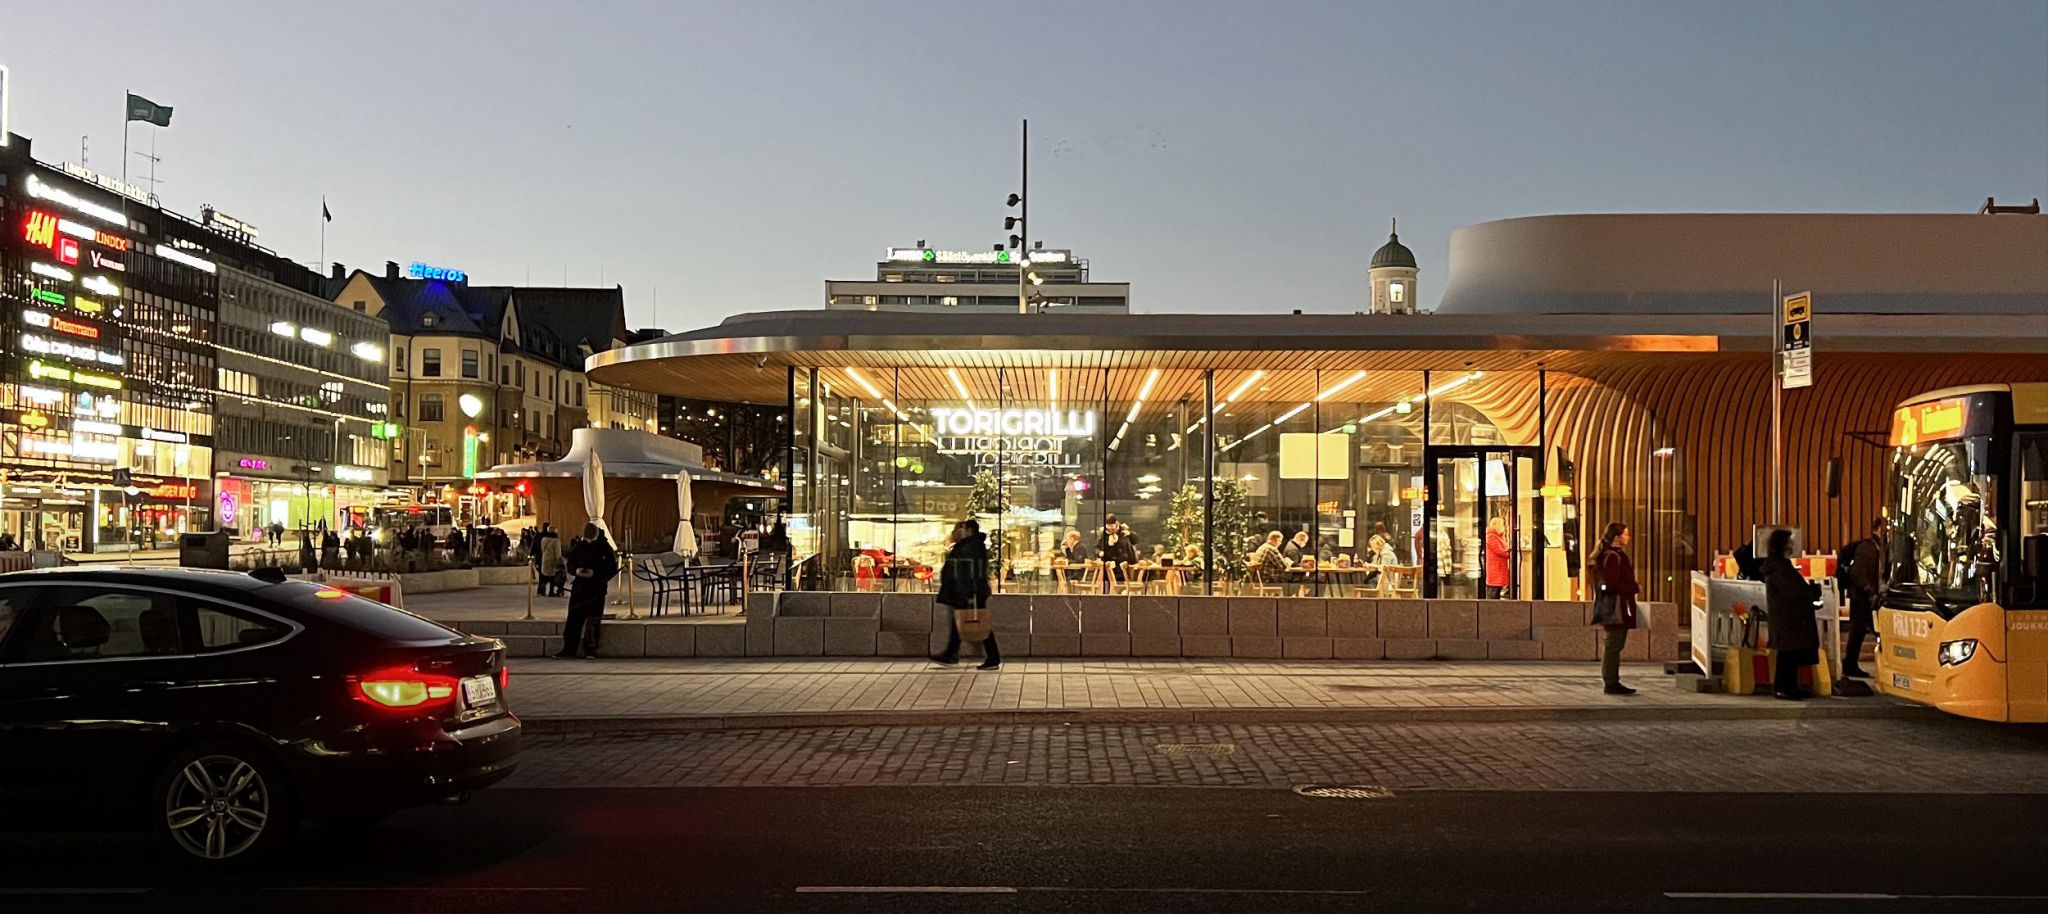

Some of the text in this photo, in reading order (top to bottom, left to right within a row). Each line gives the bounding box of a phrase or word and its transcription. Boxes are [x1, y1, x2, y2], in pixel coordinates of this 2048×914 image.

[25, 210, 57, 249] H&M
[95, 230, 127, 251] LINDEX
[408, 261, 465, 282] Heeros
[53, 316, 99, 339] Dressmann
[931, 410, 1094, 436] TORIGRILLI
[1909, 618, 1928, 638] 123
